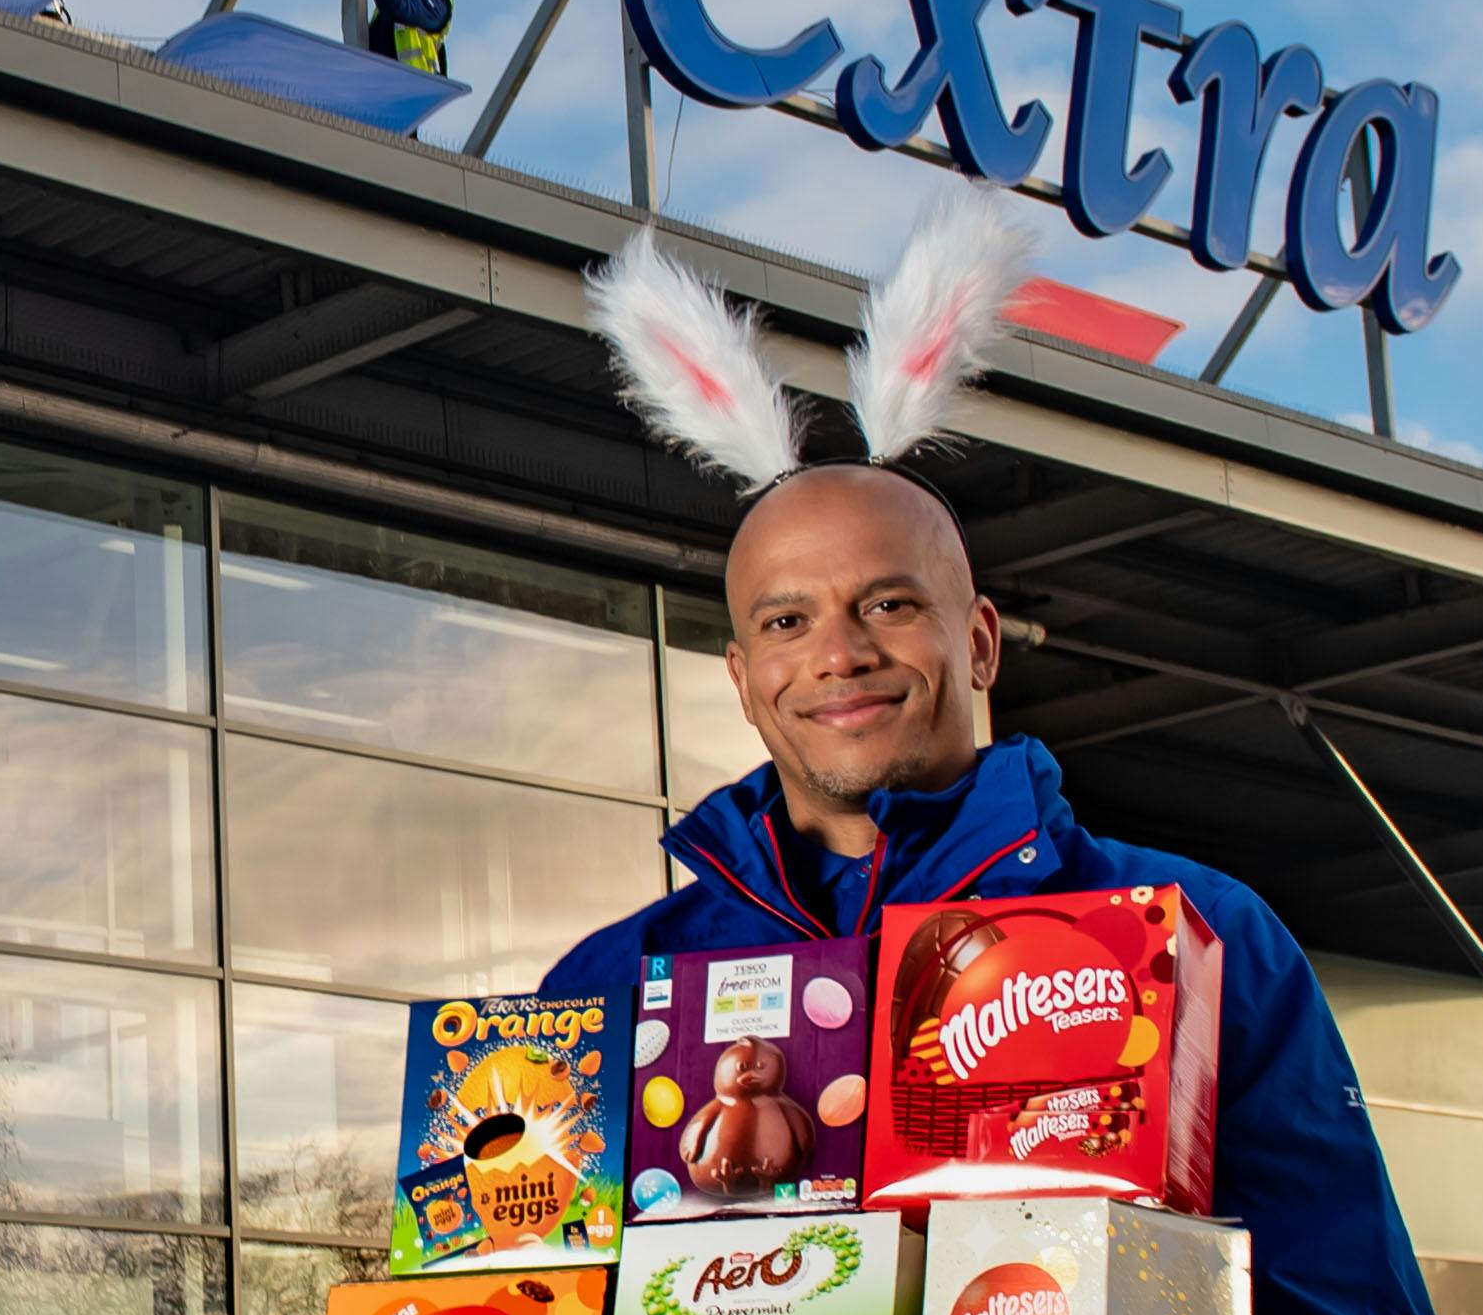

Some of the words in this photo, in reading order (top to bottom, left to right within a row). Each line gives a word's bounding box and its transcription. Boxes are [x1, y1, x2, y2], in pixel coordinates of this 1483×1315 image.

[734, 963, 768, 976] TESCO
[539, 996, 605, 1011] CHOCOLATE
[432, 1000, 605, 1050] Orange
[939, 967, 1126, 1080] Maltesers
[1010, 1113, 1090, 1161] Maltesers
[411, 1173, 465, 1202] Orange
[495, 1171, 556, 1203] mini
[493, 1196, 560, 1227] eggs
[692, 1246, 803, 1303] Aero
